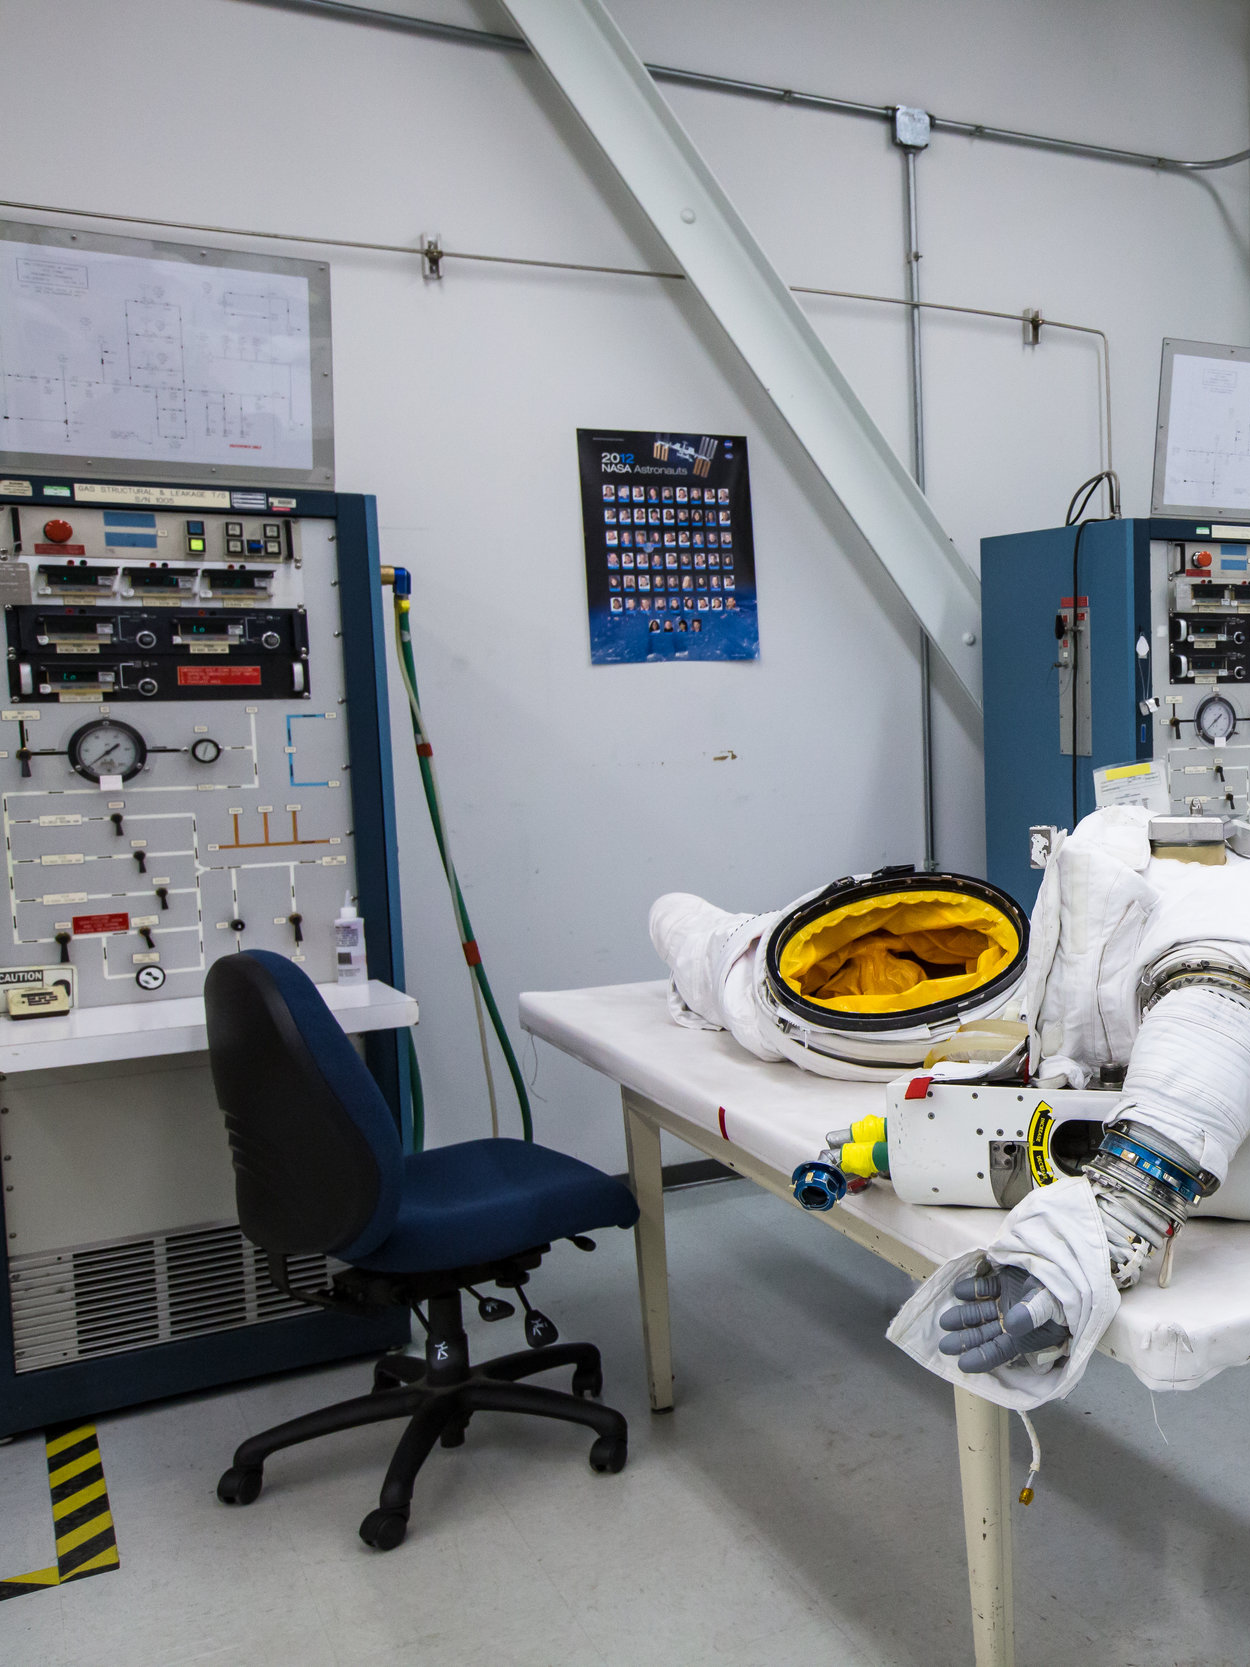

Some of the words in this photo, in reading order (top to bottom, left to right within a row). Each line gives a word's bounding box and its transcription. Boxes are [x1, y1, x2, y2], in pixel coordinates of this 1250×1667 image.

[601, 452, 635, 464] 2012
[601, 463, 633, 473] NASA
[633, 464, 688, 475] Astronauts
[78, 485, 95, 493] GAS
[100, 487, 152, 495] STRUCTURAL
[170, 490, 206, 498] LEAKAGE
[0, 971, 42, 983] CAUTION
[1036, 1117, 1045, 1143] INCREASE
